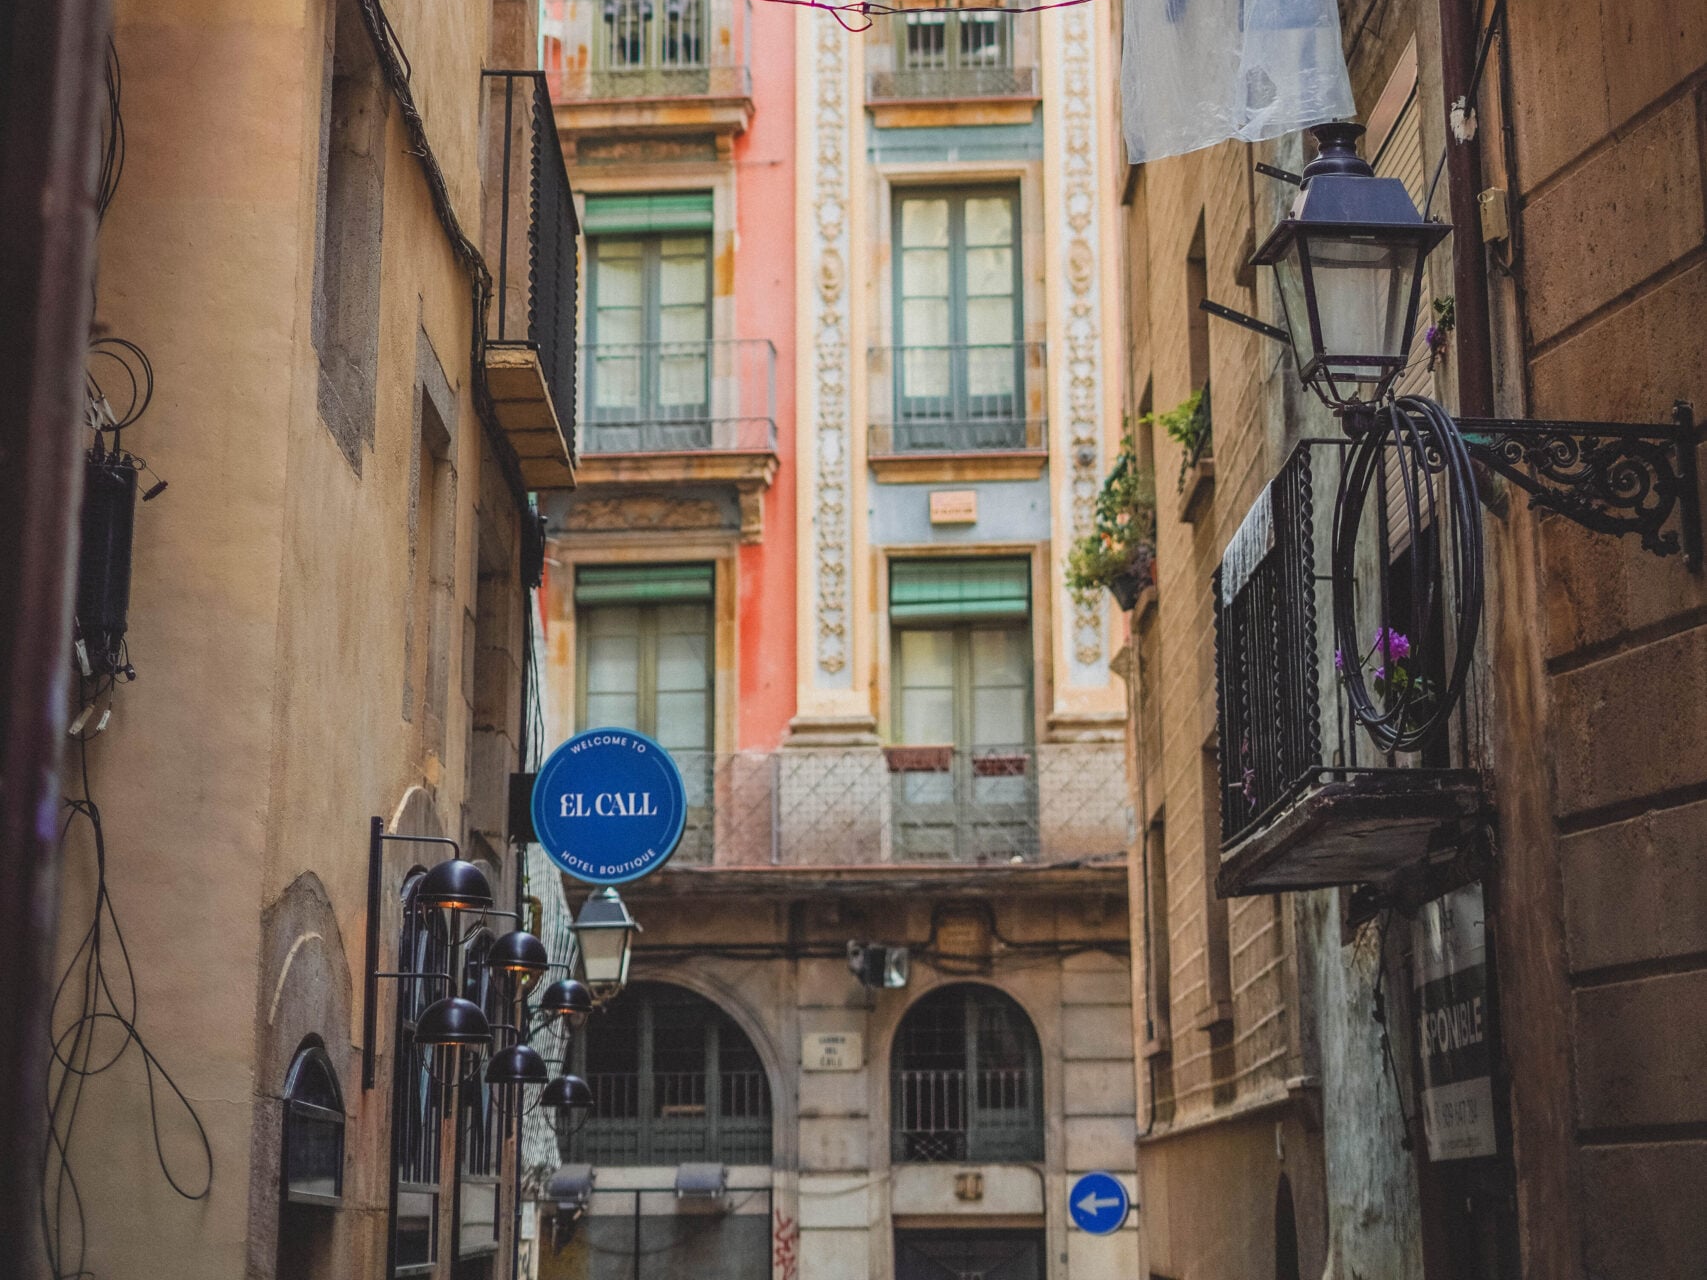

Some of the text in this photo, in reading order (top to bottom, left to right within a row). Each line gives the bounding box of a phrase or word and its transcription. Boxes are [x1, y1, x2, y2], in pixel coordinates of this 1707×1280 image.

[570, 735, 647, 755] WELCOME TO
[559, 791, 658, 818] EL CALL
[560, 848, 657, 875] HOTEL BOUTIQUE
